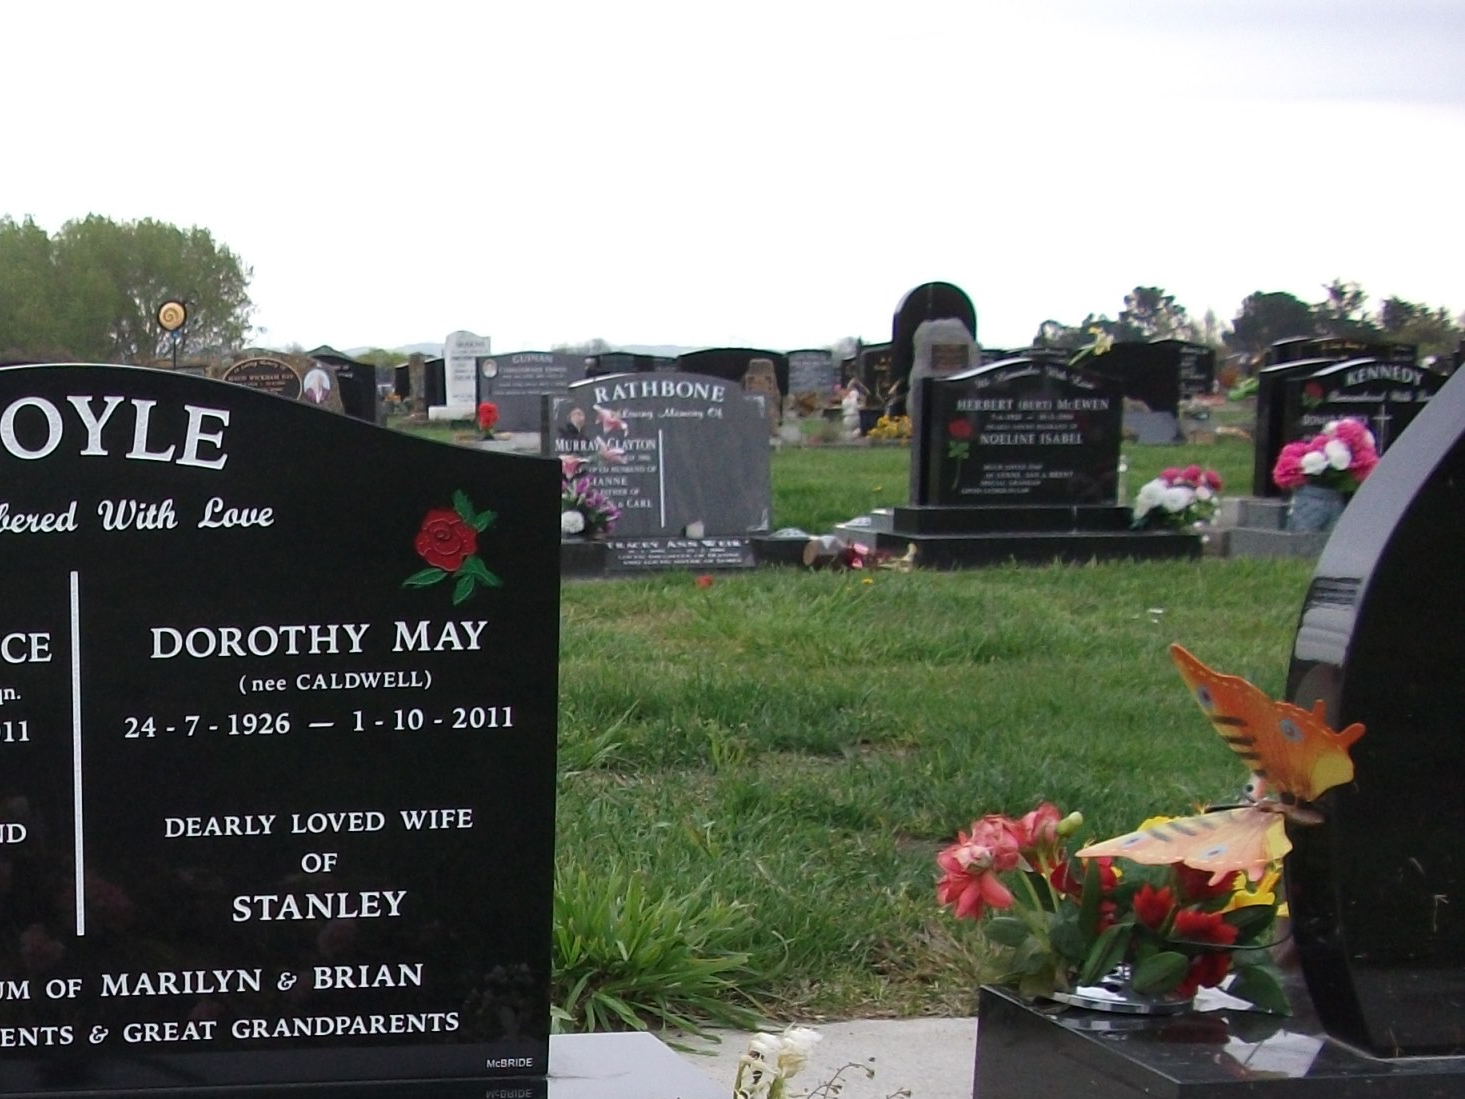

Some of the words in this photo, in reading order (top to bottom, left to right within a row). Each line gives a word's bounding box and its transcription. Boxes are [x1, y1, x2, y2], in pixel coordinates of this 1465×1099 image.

[1346, 364, 1423, 386] KENNEDY
[594, 380, 726, 404] RATHBONE
[957, 399, 1014, 411] HERBERT
[1018, 399, 1052, 411] (BERT)
[1057, 399, 1110, 411] McEWEN
[554, 438, 600, 452] MURRAY
[607, 437, 656, 450] CLAYTON
[980, 433, 1035, 444] NOELINE
[1040, 433, 1083, 444] ISABEL
[97, 498, 179, 531] With
[197, 497, 275, 529] Love
[626, 499, 653, 509] CARL
[150, 623, 371, 659] DOROTHY
[392, 620, 488, 652] MAY
[296, 670, 432, 691] CALDWELL)
[164, 814, 276, 838] DEARLY
[291, 811, 385, 834] LOVED
[400, 808, 473, 830] WIFE
[301, 852, 338, 873] OF
[232, 890, 407, 922] STANLEY
[45, 978, 83, 999] OF
[100, 968, 262, 997] MARILYN
[277, 971, 297, 991] &
[313, 963, 424, 990] BRIAN
[88, 1025, 109, 1044] &
[123, 1020, 217, 1043] GREAT
[231, 1012, 459, 1039] GRANDPARENTS
[486, 1058, 533, 1068] McBRIDE
